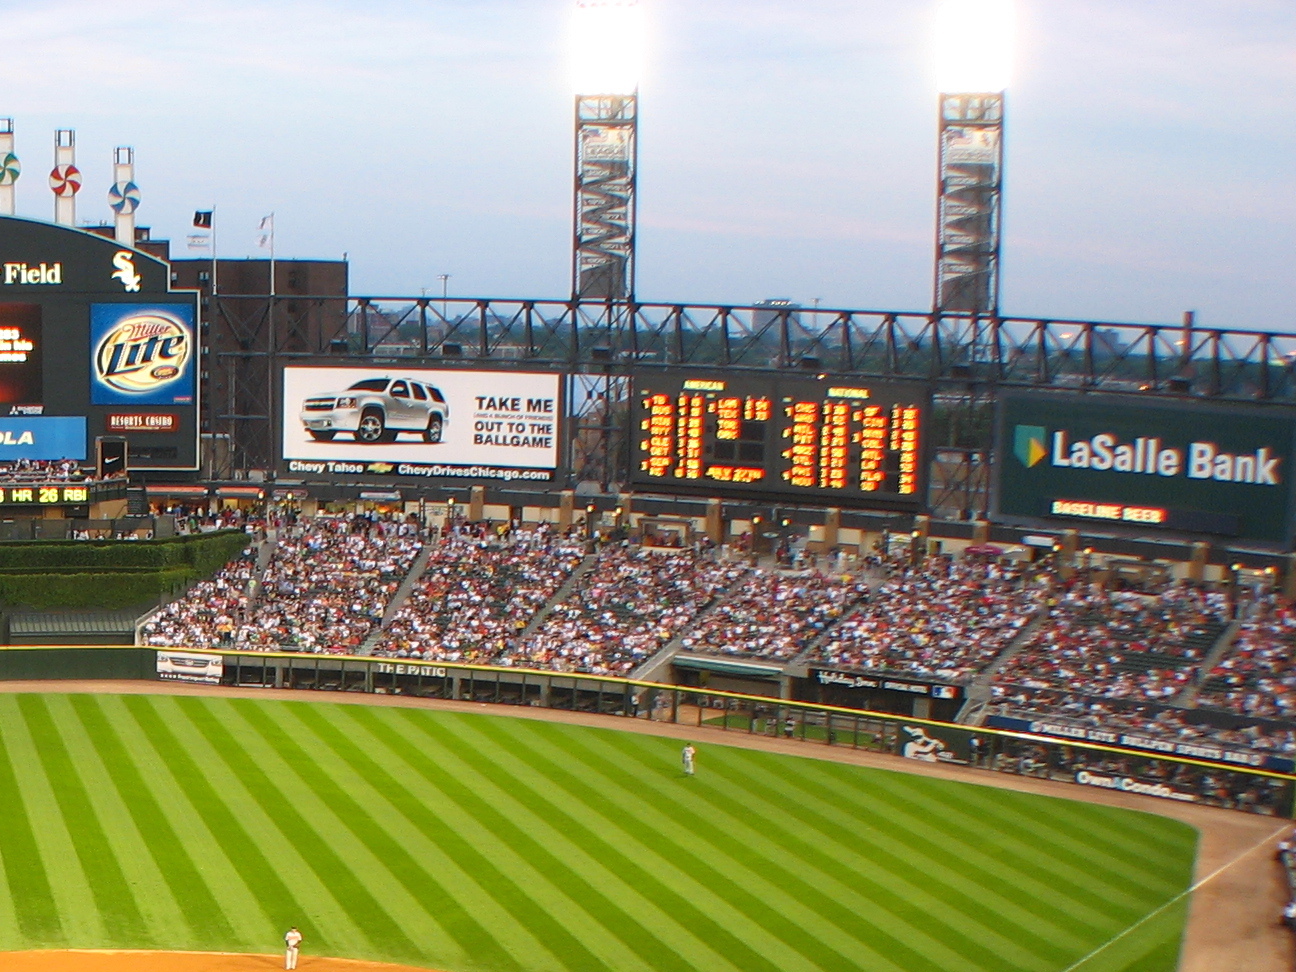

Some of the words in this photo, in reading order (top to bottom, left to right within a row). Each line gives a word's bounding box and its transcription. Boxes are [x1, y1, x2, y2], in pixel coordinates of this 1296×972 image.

[3, 262, 62, 285] Field
[122, 323, 174, 339] Miller
[104, 334, 187, 377] Lite
[474, 395, 522, 412] TAKE
[526, 398, 554, 413] ME
[110, 415, 143, 426] RESORTS
[145, 415, 173, 426] CASINO
[474, 420, 504, 433] OUT
[506, 422, 526, 434] TO
[529, 423, 554, 435] THE
[473, 433, 554, 449] BALLGAME
[1052, 430, 1183, 477] LaSalle
[1187, 441, 1281, 485] Bank
[289, 461, 326, 474] Chevy
[326, 462, 364, 474] Tahoe
[398, 464, 551, 481] ChevyDrivesChicago.com
[12, 489, 34, 503] HR
[39, 488, 59, 503] 26
[63, 488, 88, 502] RBI
[1051, 500, 1122, 520] BASELINE
[377, 662, 404, 675] THE
